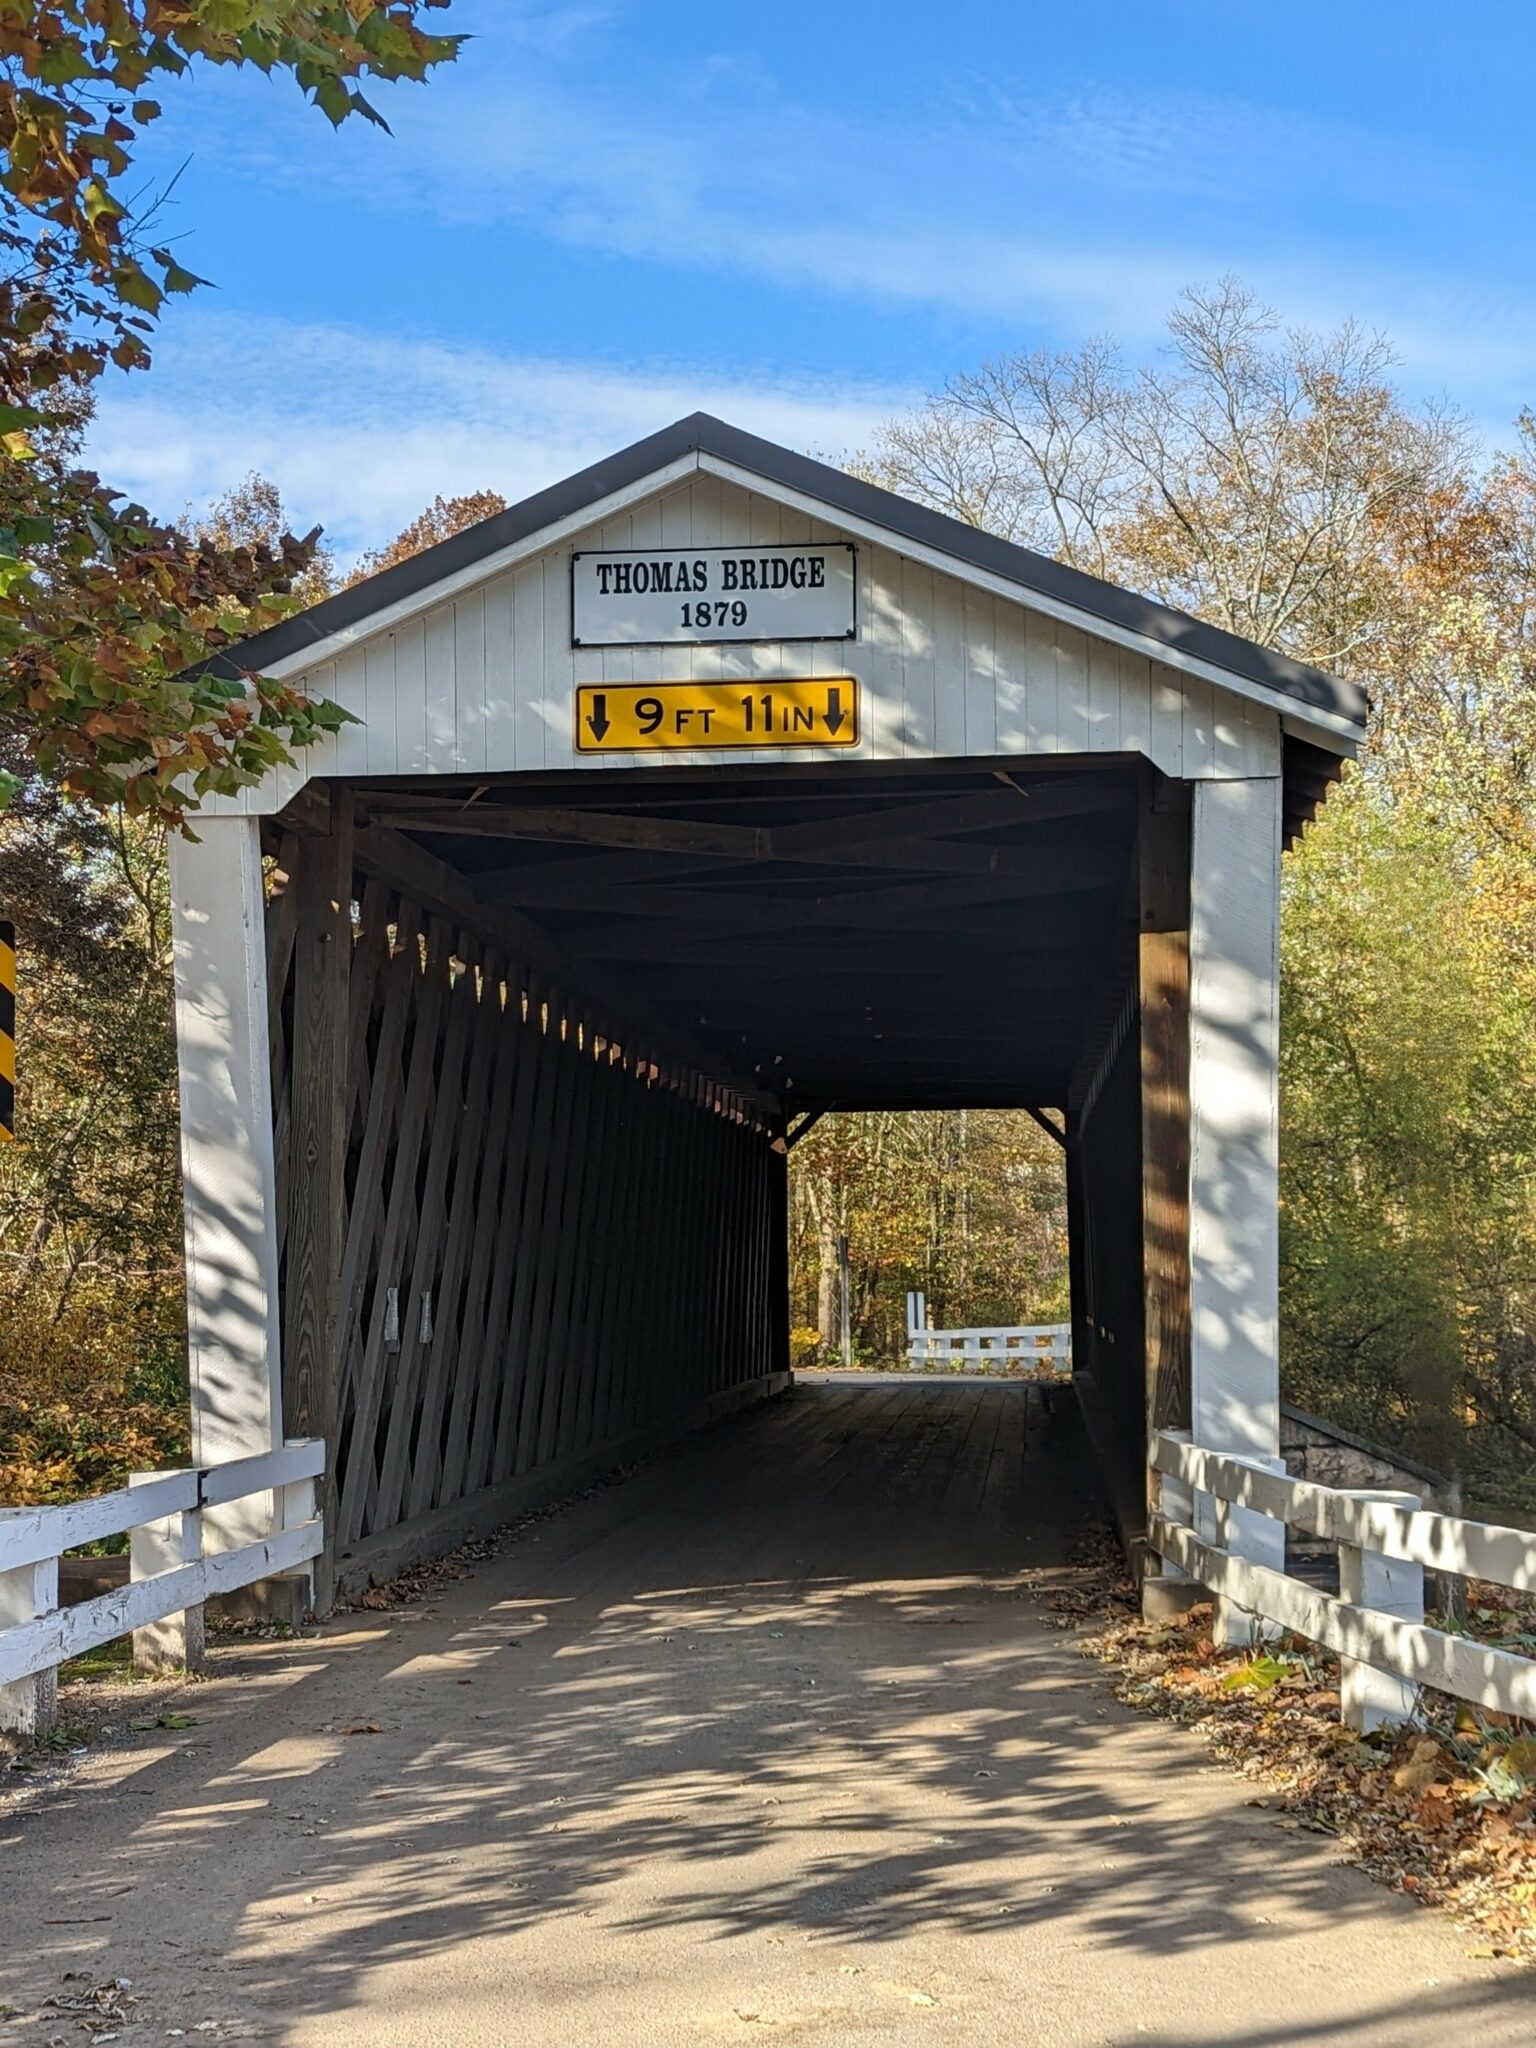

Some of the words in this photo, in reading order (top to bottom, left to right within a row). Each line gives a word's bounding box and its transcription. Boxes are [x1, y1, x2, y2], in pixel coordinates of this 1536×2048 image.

[596, 560, 708, 595] THOMAS
[721, 556, 825, 591] BRIDGE
[680, 600, 748, 628] 1879
[634, 697, 664, 735] 9
[676, 709, 716, 734] FT
[741, 695, 773, 732] 11
[783, 706, 814, 732] IN
